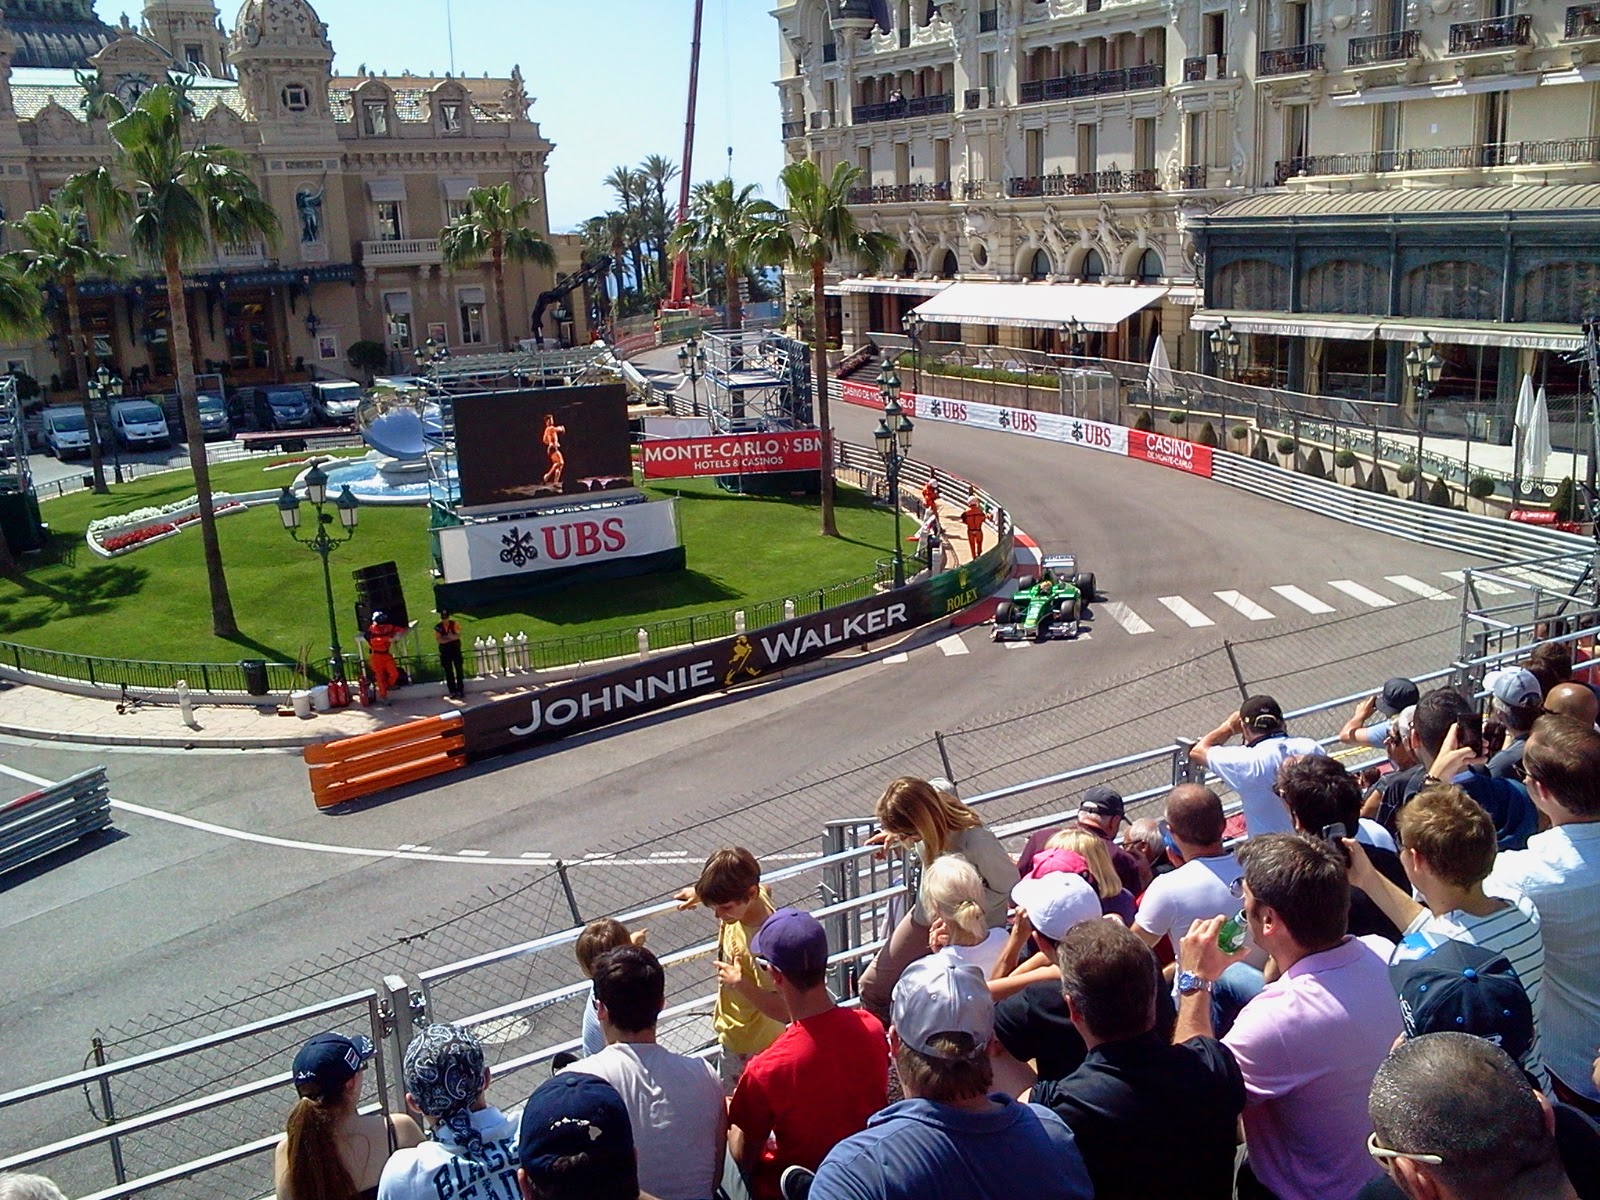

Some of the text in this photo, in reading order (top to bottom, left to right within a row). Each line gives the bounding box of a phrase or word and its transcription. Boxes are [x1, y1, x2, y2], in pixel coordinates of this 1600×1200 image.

[843, 385, 861, 398] CASINO
[862, 389, 870, 400] DE
[942, 401, 967, 421] UBS
[1011, 411, 1037, 433] UBS
[1084, 423, 1111, 448] UBS
[645, 440, 780, 462] MONTE-CARLO
[1146, 434, 1193, 460] CASINO
[694, 455, 784, 470] HOTELS & CASINOS
[1146, 450, 1193, 470] DE MONTE-CARLO
[541, 517, 626, 560] UBS
[508, 602, 908, 736] JOHNNIE WALKER
